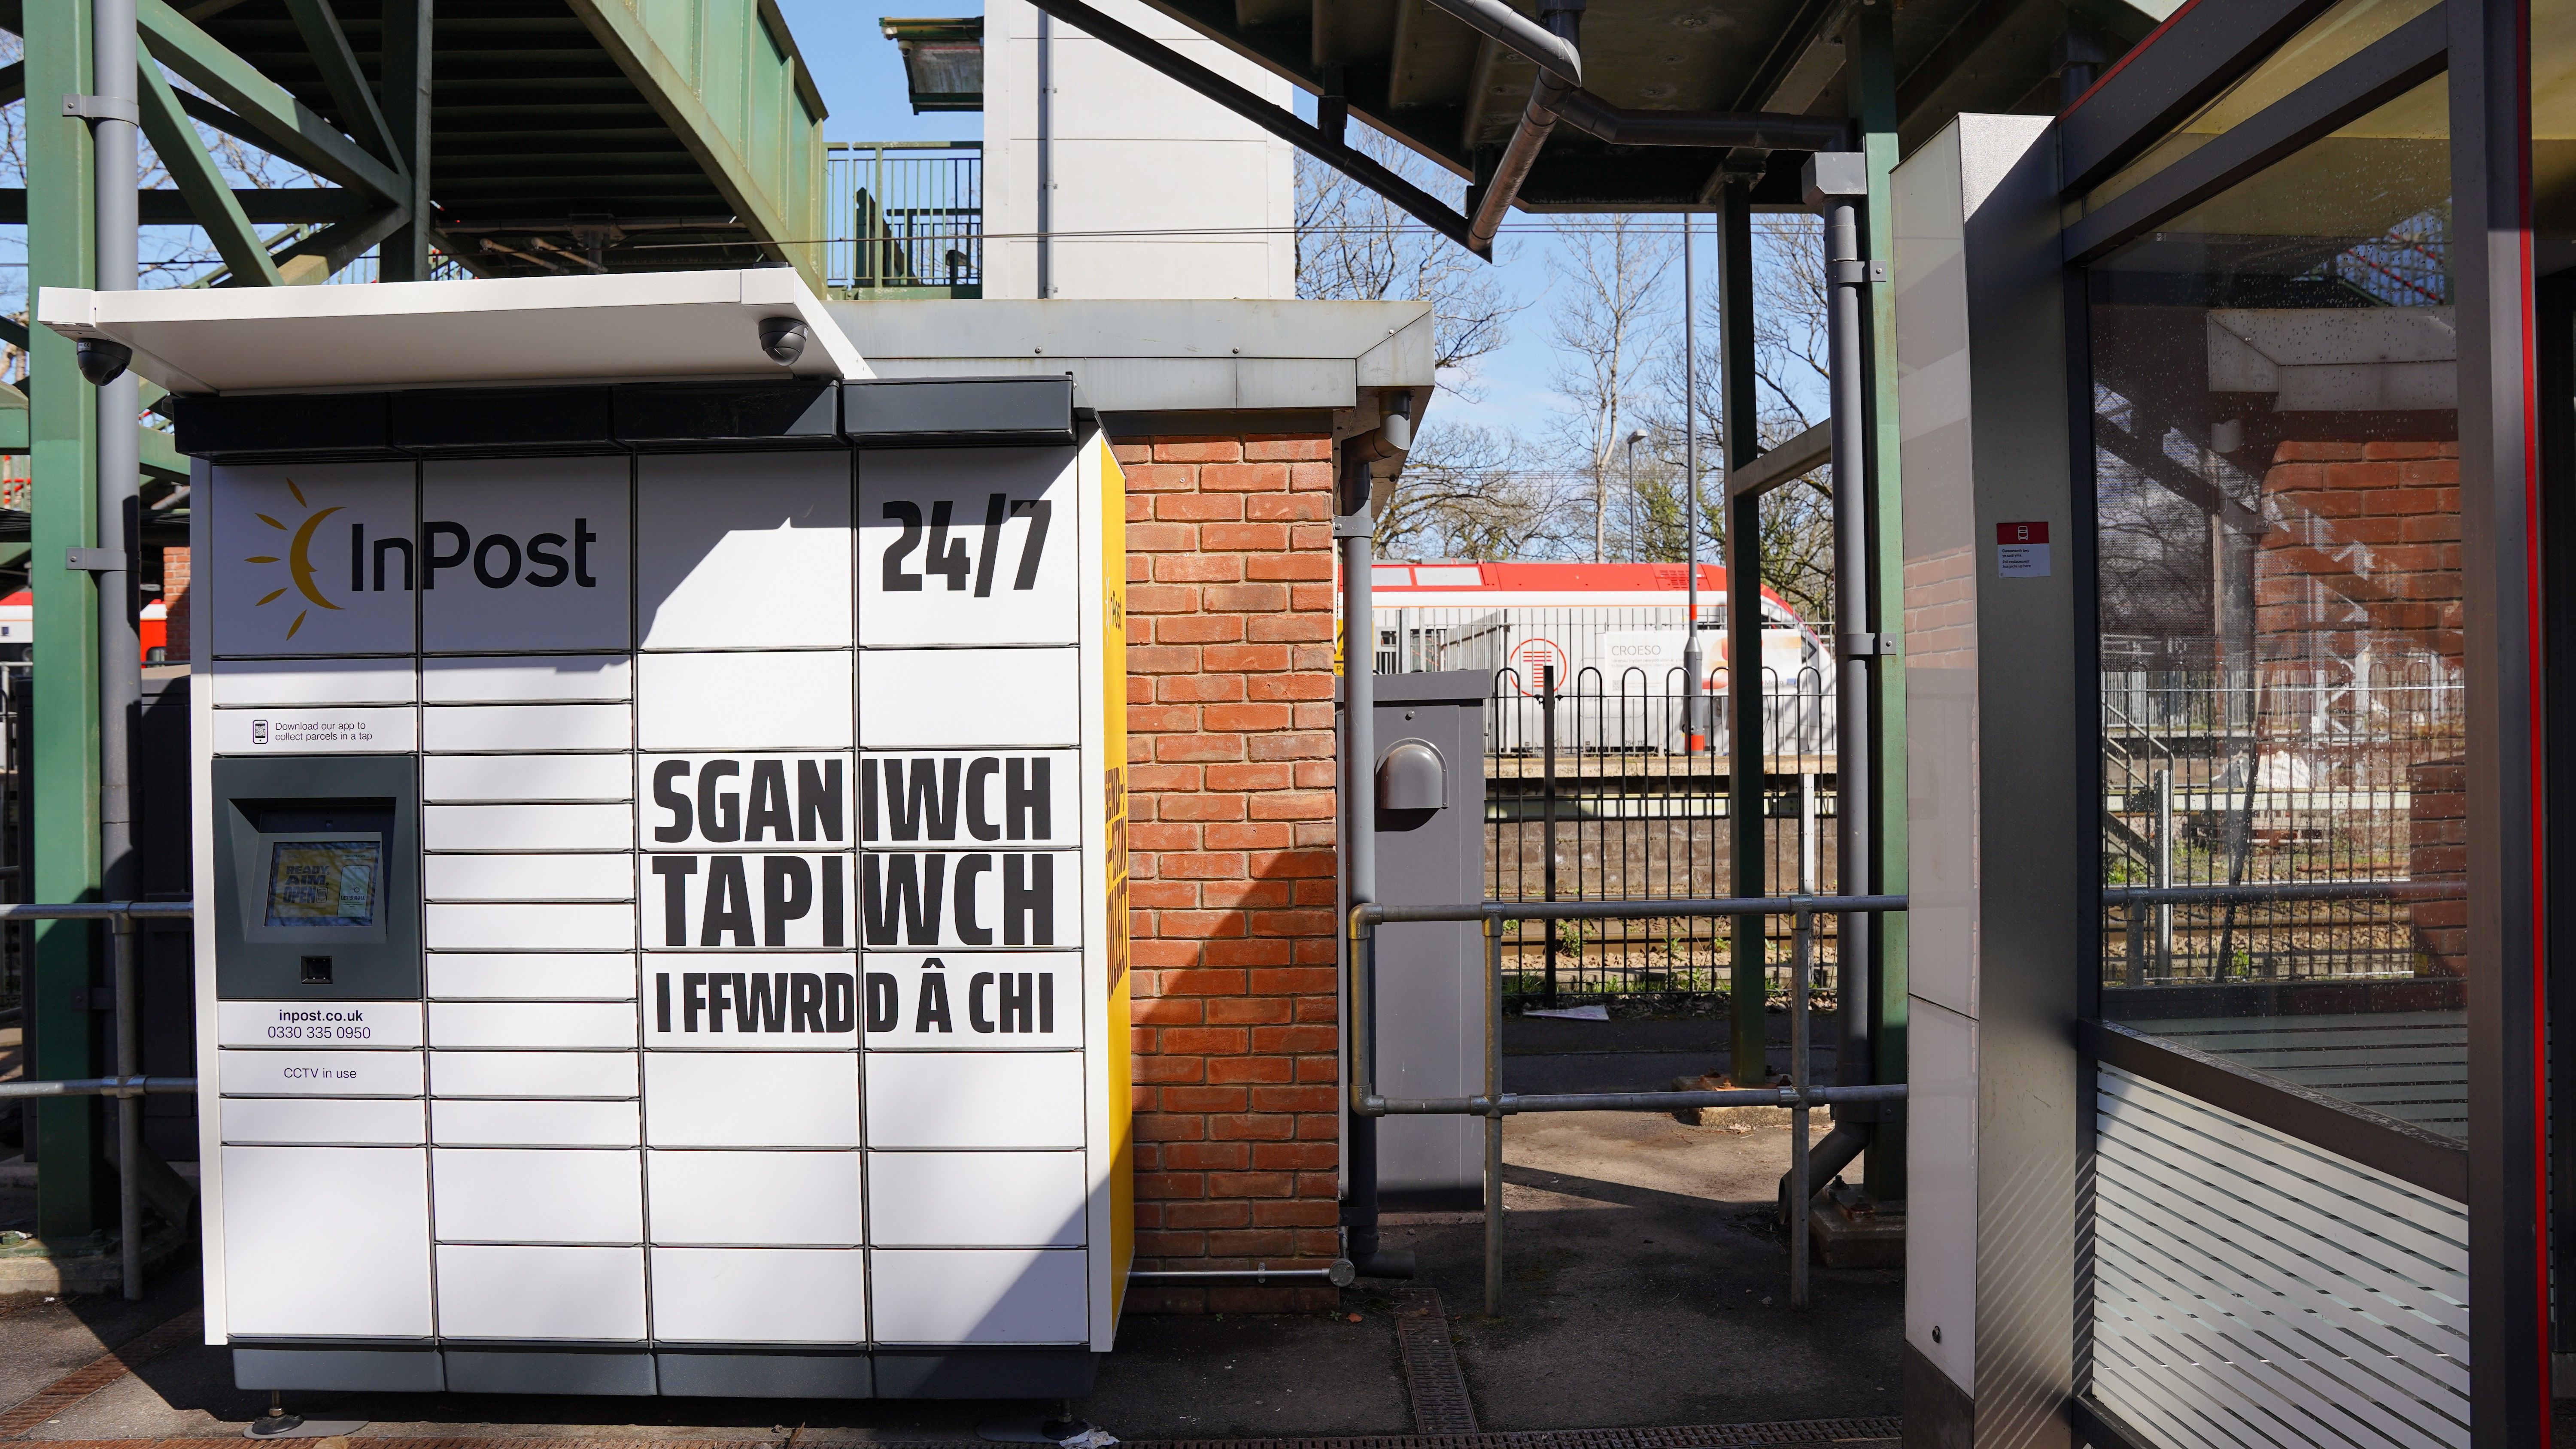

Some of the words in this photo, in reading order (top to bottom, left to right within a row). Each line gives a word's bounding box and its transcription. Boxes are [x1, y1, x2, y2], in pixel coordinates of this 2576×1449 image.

[352, 518, 596, 591] InPost
[883, 494, 1051, 597] 24/7
[1109, 587, 1121, 631] InPost
[1612, 646, 1661, 655] CROESO
[276, 722, 318, 730] Download
[306, 732, 337, 742] parcels
[359, 733, 372, 741] tap
[653, 757, 1051, 843] SGANIWCH
[1106, 767, 1120, 824] SEND
[1112, 815, 1127, 882] RETURN
[285, 875, 329, 886] AIM,
[286, 865, 330, 875] READY,
[283, 886, 316, 903] OPEN
[652, 854, 1054, 947] TAPIWCH
[1107, 875, 1127, 1002] COLLECT
[656, 973, 671, 1033] I
[683, 973, 899, 1033] FFWRDD
[915, 958, 953, 1033] Â
[969, 972, 1054, 1034] CHI
[280, 1009, 363, 1023] inpost.co.uk
[268, 1026, 301, 1038] 0330
[307, 1027, 331, 1038] 335
[337, 1027, 370, 1038] 0950
[284, 1068, 318, 1078] CCTV
[323, 1068, 331, 1078] in
